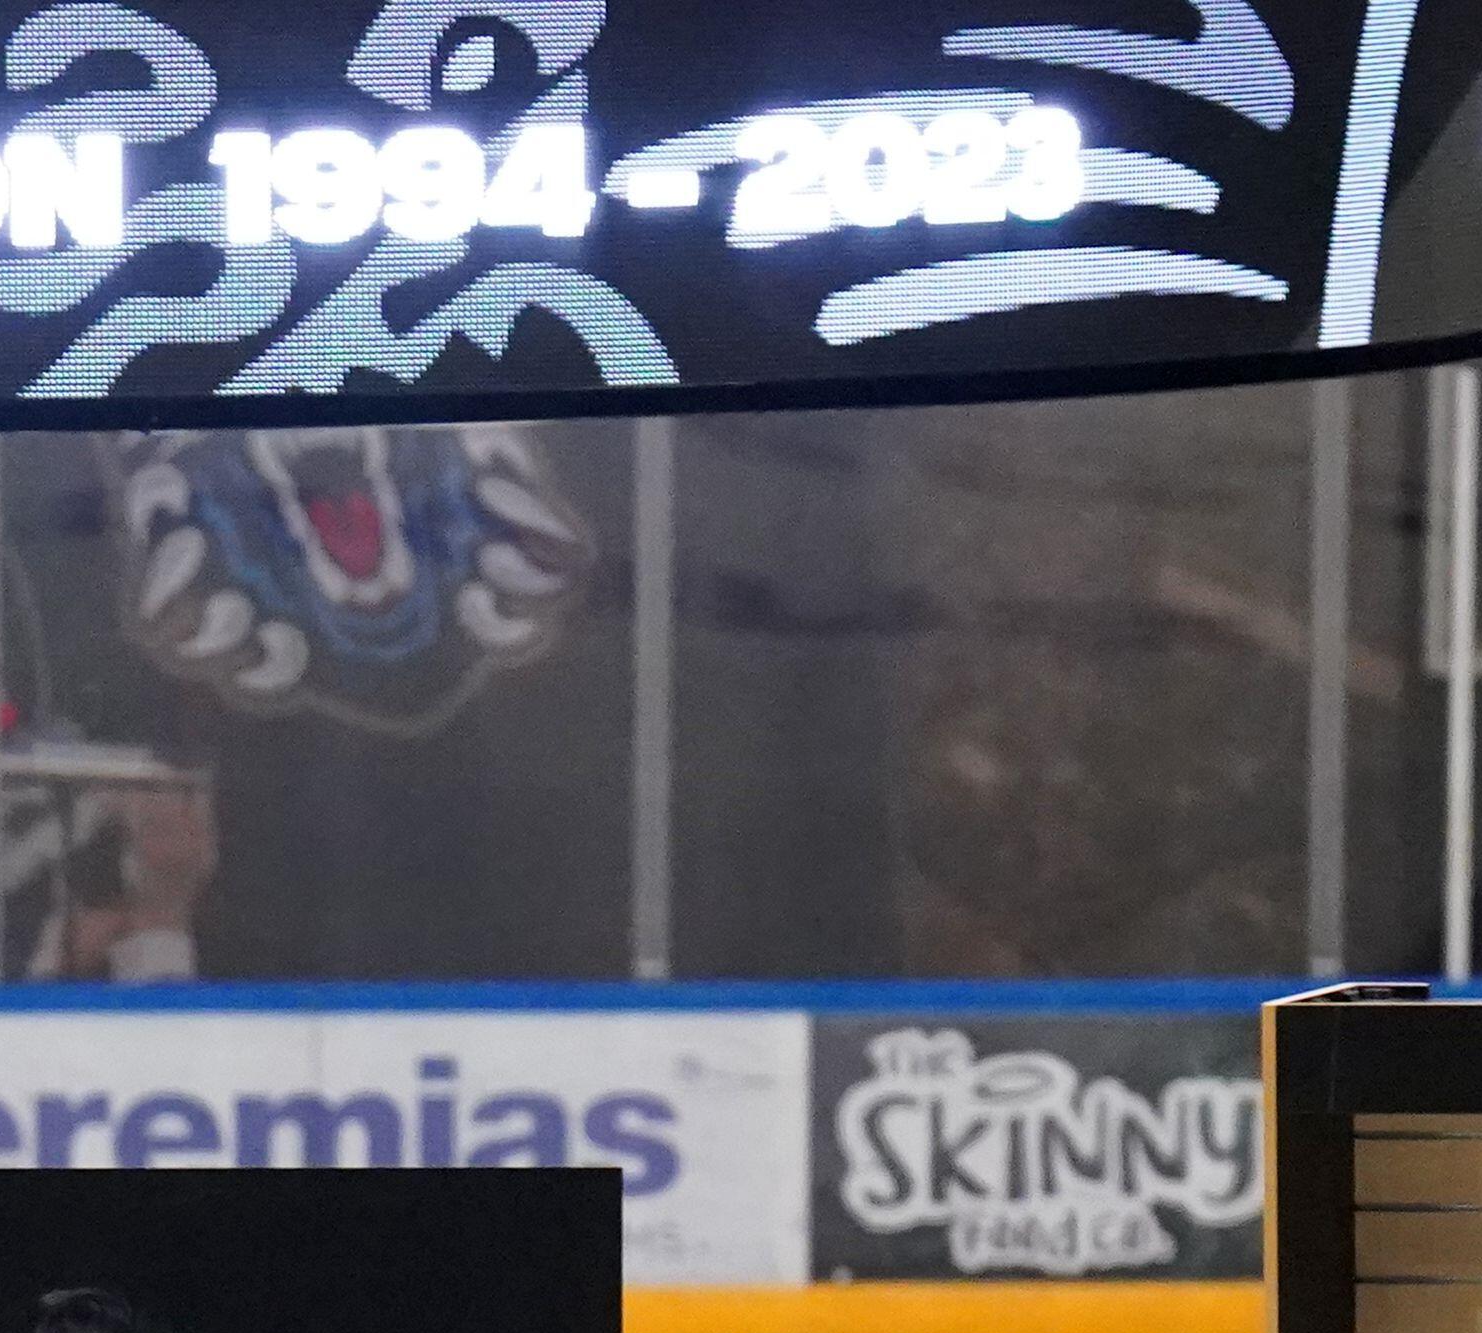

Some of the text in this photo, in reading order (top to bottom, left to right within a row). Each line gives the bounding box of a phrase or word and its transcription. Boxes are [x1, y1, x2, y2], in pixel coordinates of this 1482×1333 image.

[208, 126, 594, 246] 1994
[726, 106, 1084, 247] 2023
[858, 1094, 1261, 1208] SKINNY
